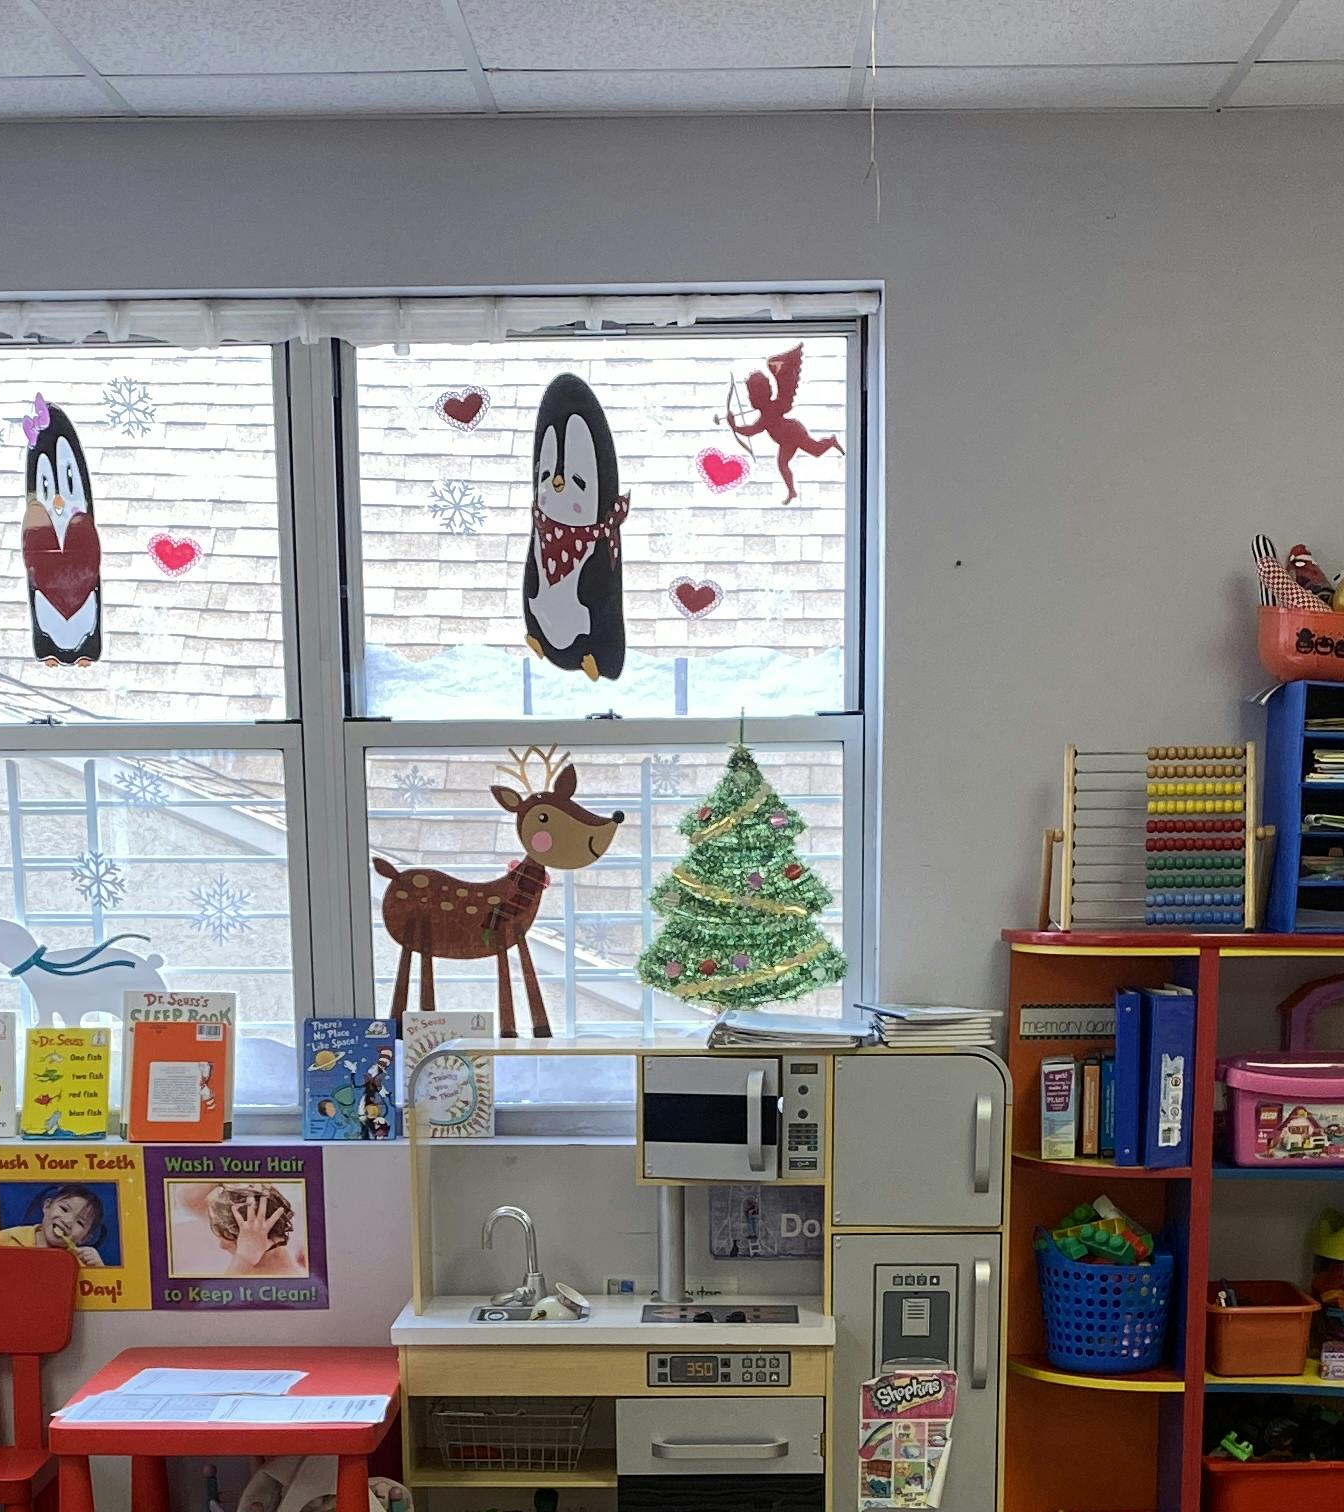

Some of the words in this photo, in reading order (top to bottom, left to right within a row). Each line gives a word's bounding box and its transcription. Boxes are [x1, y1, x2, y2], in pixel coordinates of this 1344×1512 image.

[144, 993, 164, 1007] Dr.
[1022, 1019, 1082, 1035] memory
[57, 1034, 84, 1047] Seuss
[313, 1031, 325, 1040] No
[327, 1029, 350, 1039] Place
[311, 1041, 330, 1050] Like
[331, 1036, 359, 1049] Space!
[70, 1053, 85, 1061] One
[87, 1053, 102, 1062] fish
[89, 1072, 104, 1080] fish
[68, 1090, 82, 1098] red
[83, 1090, 98, 1098] fish
[86, 1109, 102, 1117] fish
[35, 1153, 79, 1170] Your
[85, 1153, 135, 1171] Teeth
[164, 1156, 214, 1172] Wash
[219, 1156, 261, 1173] Your
[266, 1155, 304, 1173] Hair
[79, 1279, 123, 1303] Day!
[164, 1288, 182, 1302] to
[189, 1286, 233, 1304] Keep
[239, 1286, 252, 1301] It
[258, 1286, 317, 1302] Clean!
[686, 1362, 714, 1377] 350
[876, 1376, 942, 1407] Shopkins
